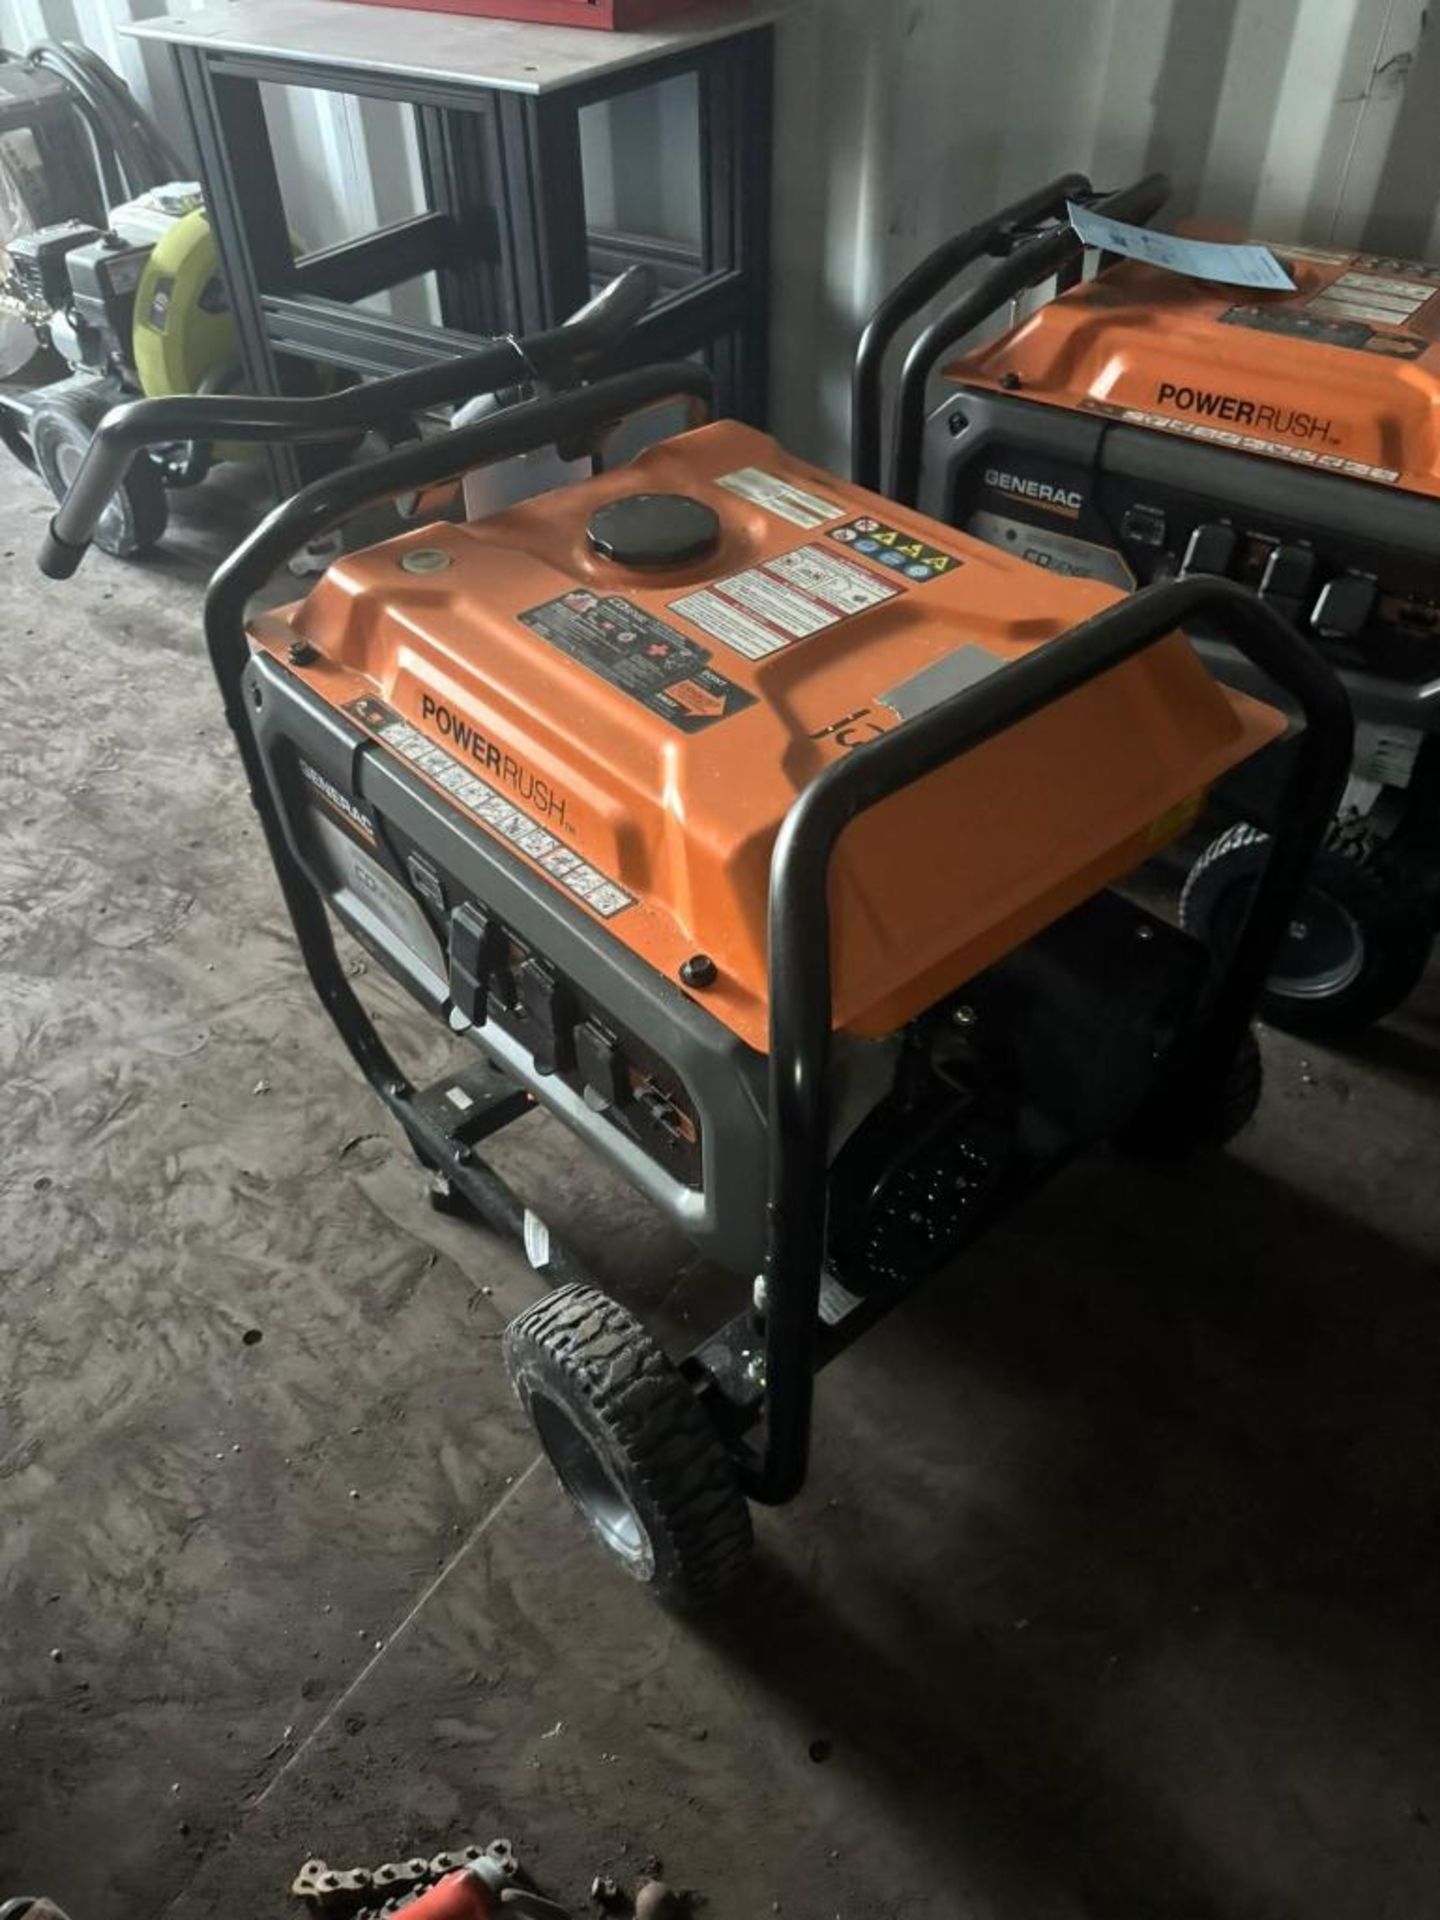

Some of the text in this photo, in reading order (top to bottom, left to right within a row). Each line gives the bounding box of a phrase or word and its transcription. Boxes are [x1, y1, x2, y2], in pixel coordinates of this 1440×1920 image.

[1156, 383, 1332, 442] POWERRUSH
[984, 469, 1083, 509] GENERAC
[422, 693, 567, 825] POWERRUSH
